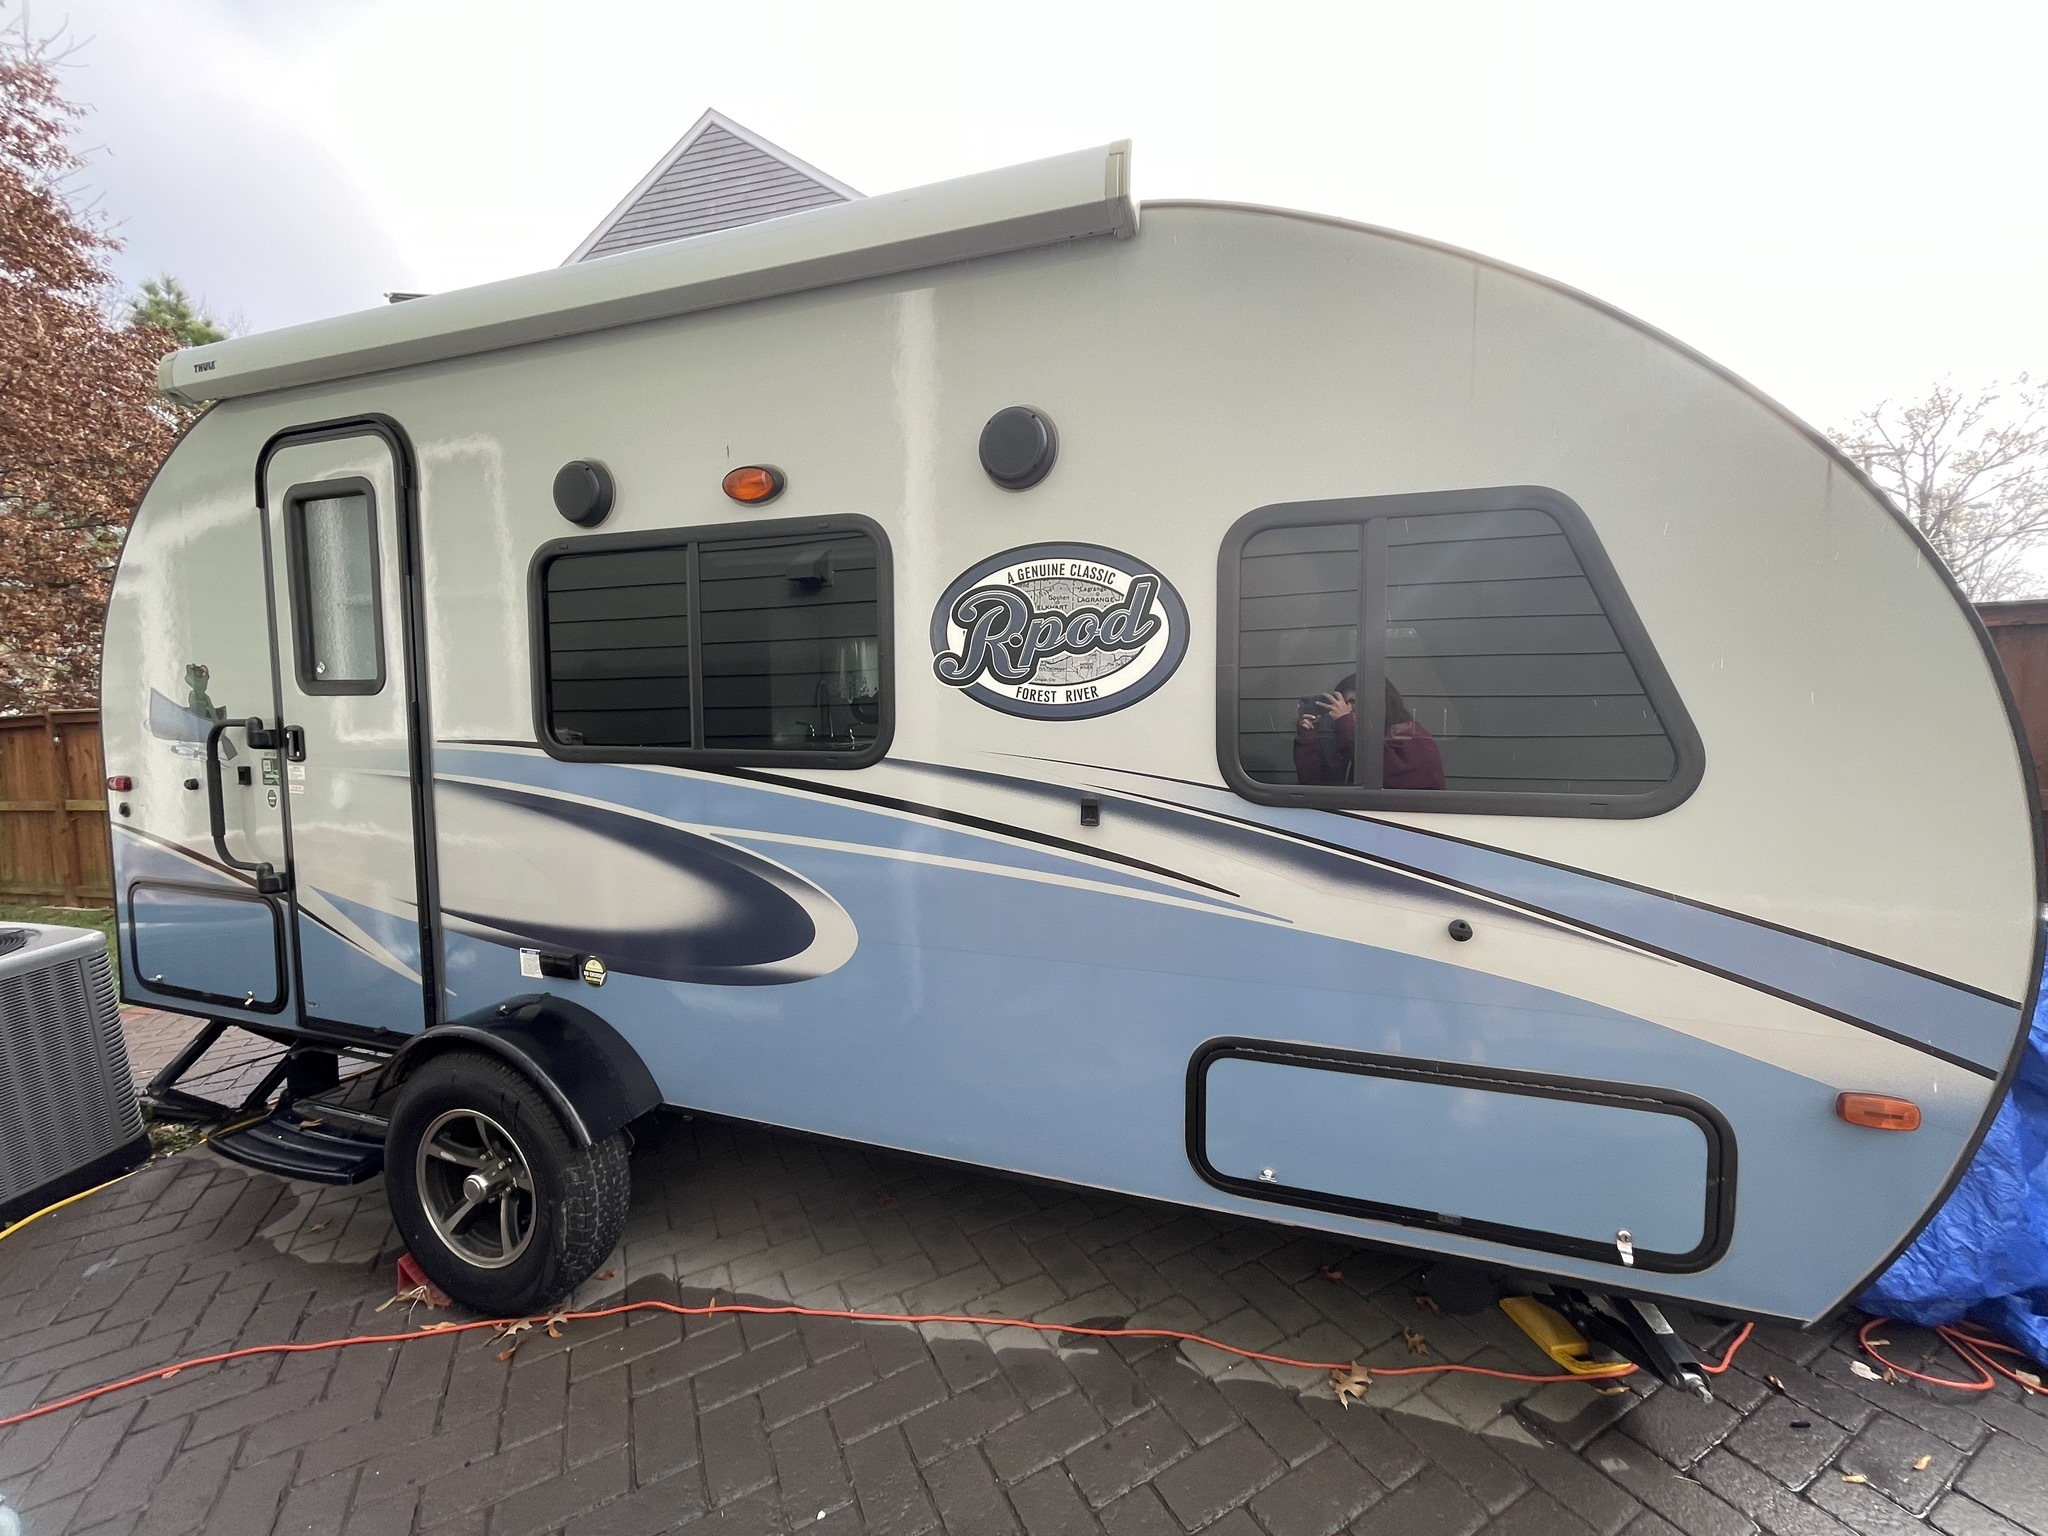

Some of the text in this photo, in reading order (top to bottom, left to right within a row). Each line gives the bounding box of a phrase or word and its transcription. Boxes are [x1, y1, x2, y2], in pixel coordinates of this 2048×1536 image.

[194, 361, 216, 373] THULE
[1007, 563, 1116, 585] A GENUINE CLASSIC
[1016, 685, 1099, 703] FOREST RIVER
